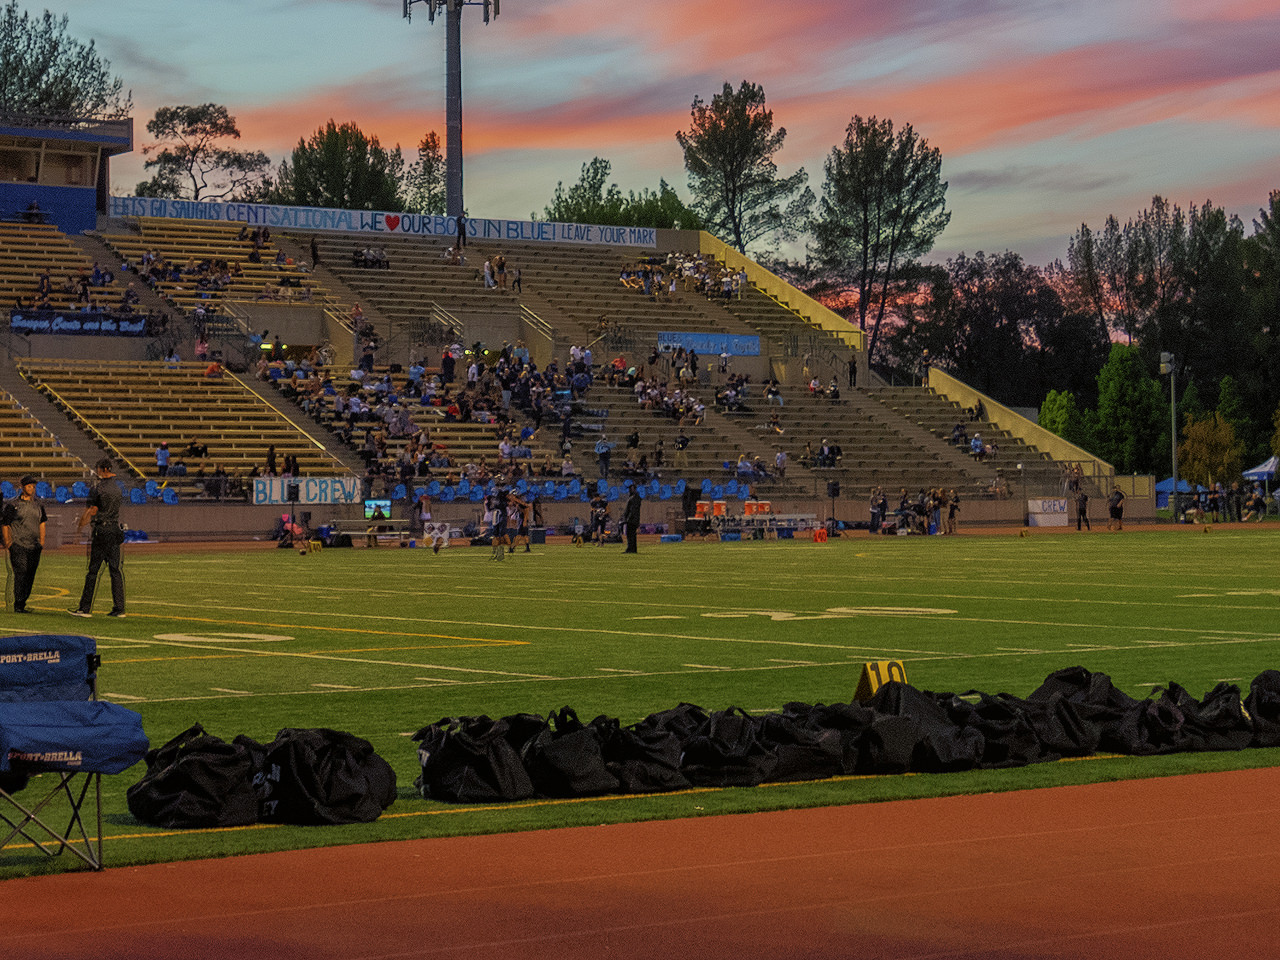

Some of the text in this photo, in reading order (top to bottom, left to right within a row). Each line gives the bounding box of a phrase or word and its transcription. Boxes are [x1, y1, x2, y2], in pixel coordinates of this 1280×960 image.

[360, 212, 556, 241] WE OUR BOS IN BLUE!
[561, 224, 655, 245] LEAVE YOUR MARK
[305, 478, 357, 504] CREW
[1042, 500, 1067, 513] CREW
